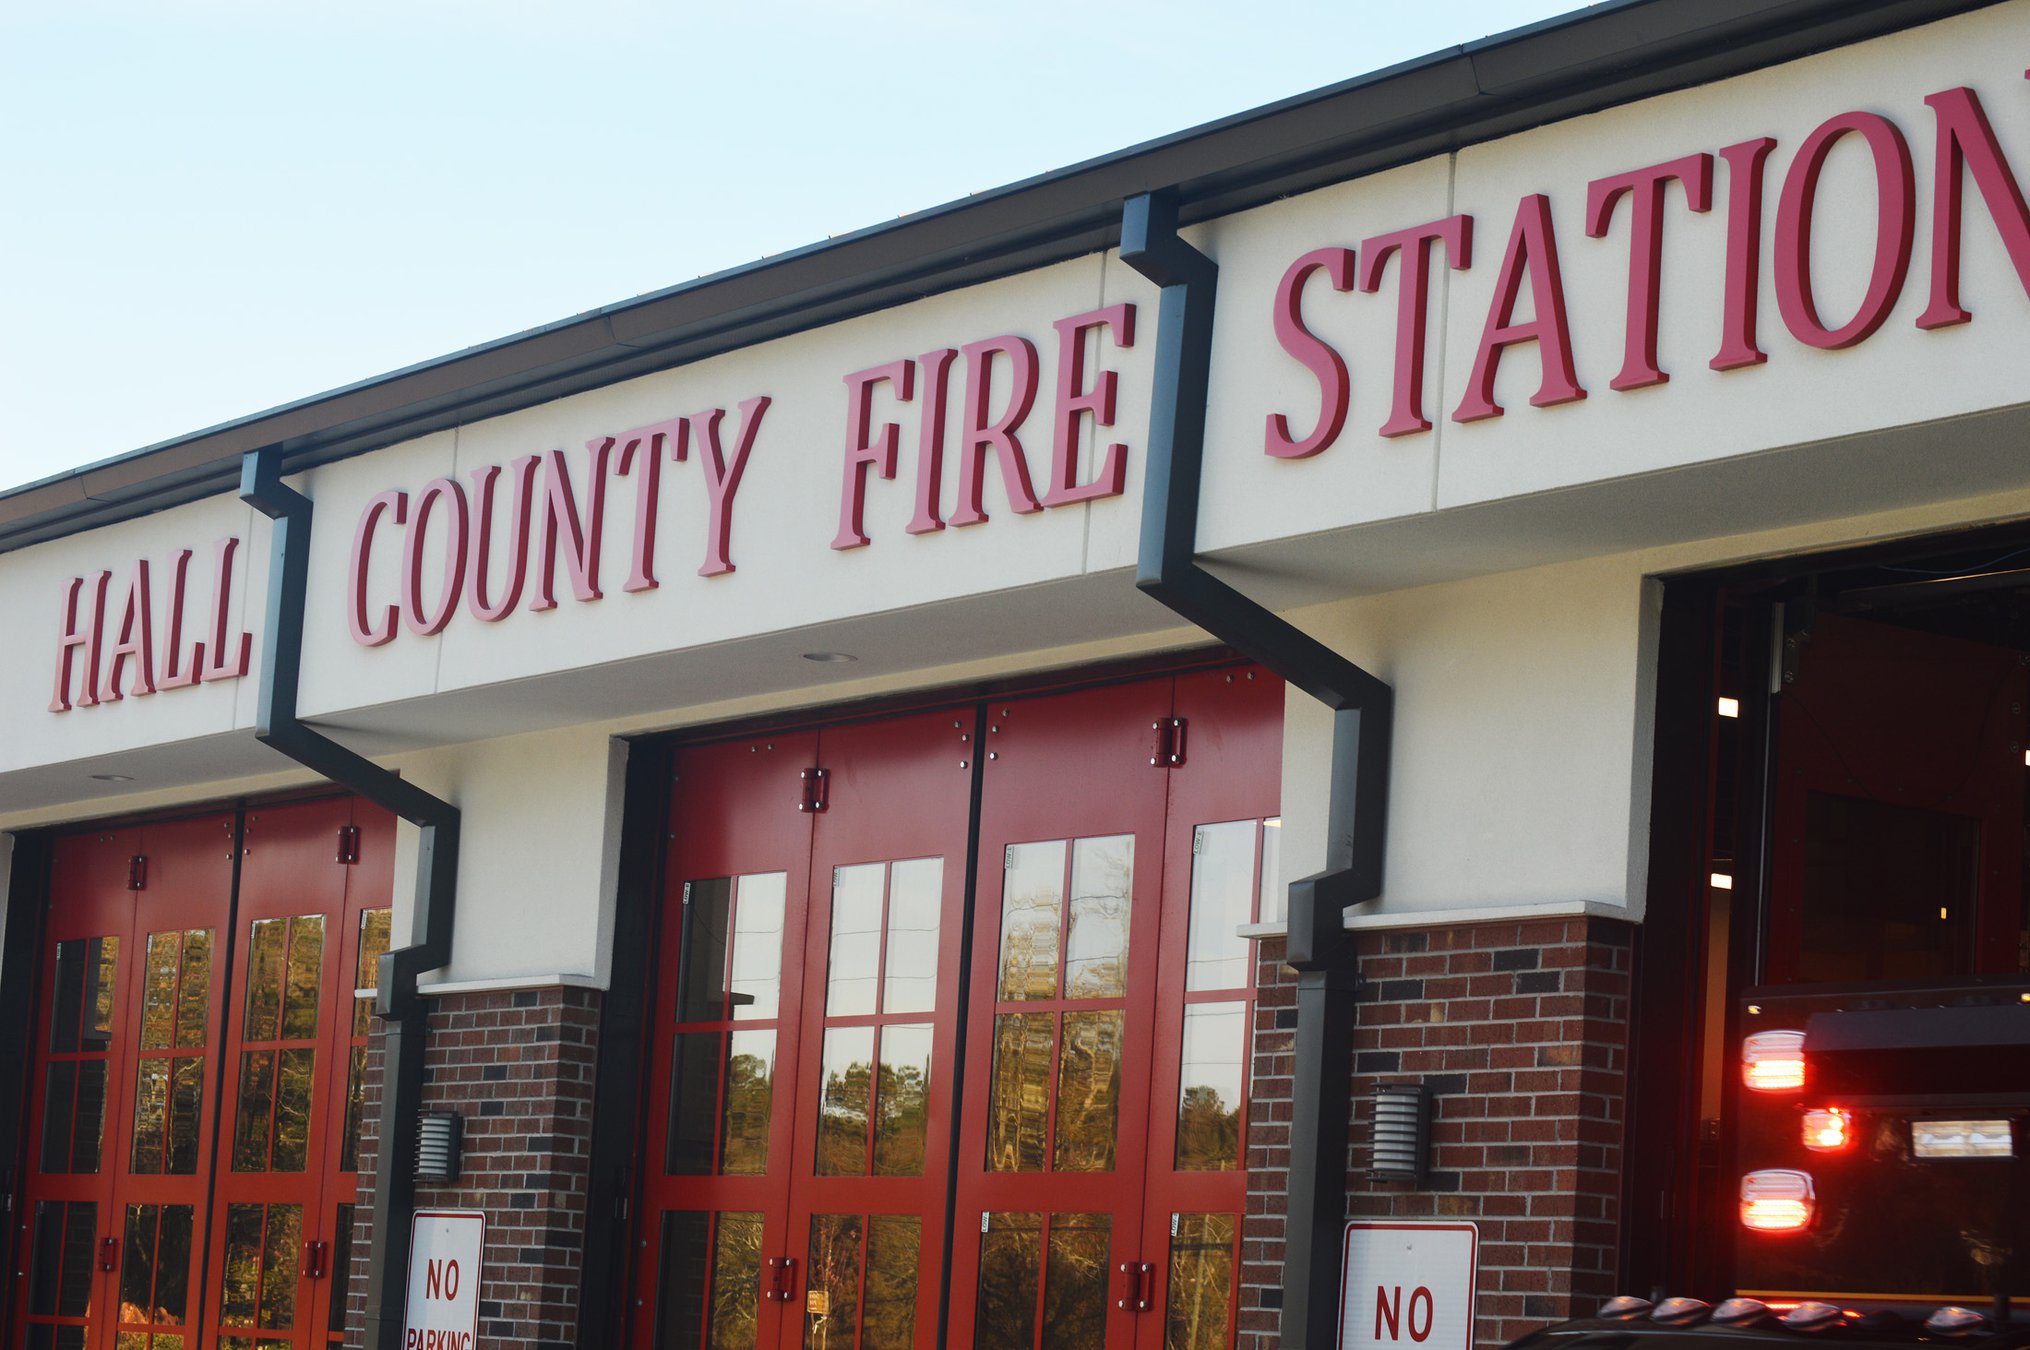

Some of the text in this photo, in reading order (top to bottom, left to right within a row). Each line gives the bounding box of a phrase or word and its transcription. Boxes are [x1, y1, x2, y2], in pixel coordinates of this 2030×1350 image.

[48, 69, 2030, 713] HALL COUNTY FIRE STATION
[426, 1258, 459, 1301] NO
[1375, 1286, 1433, 1342] NO
